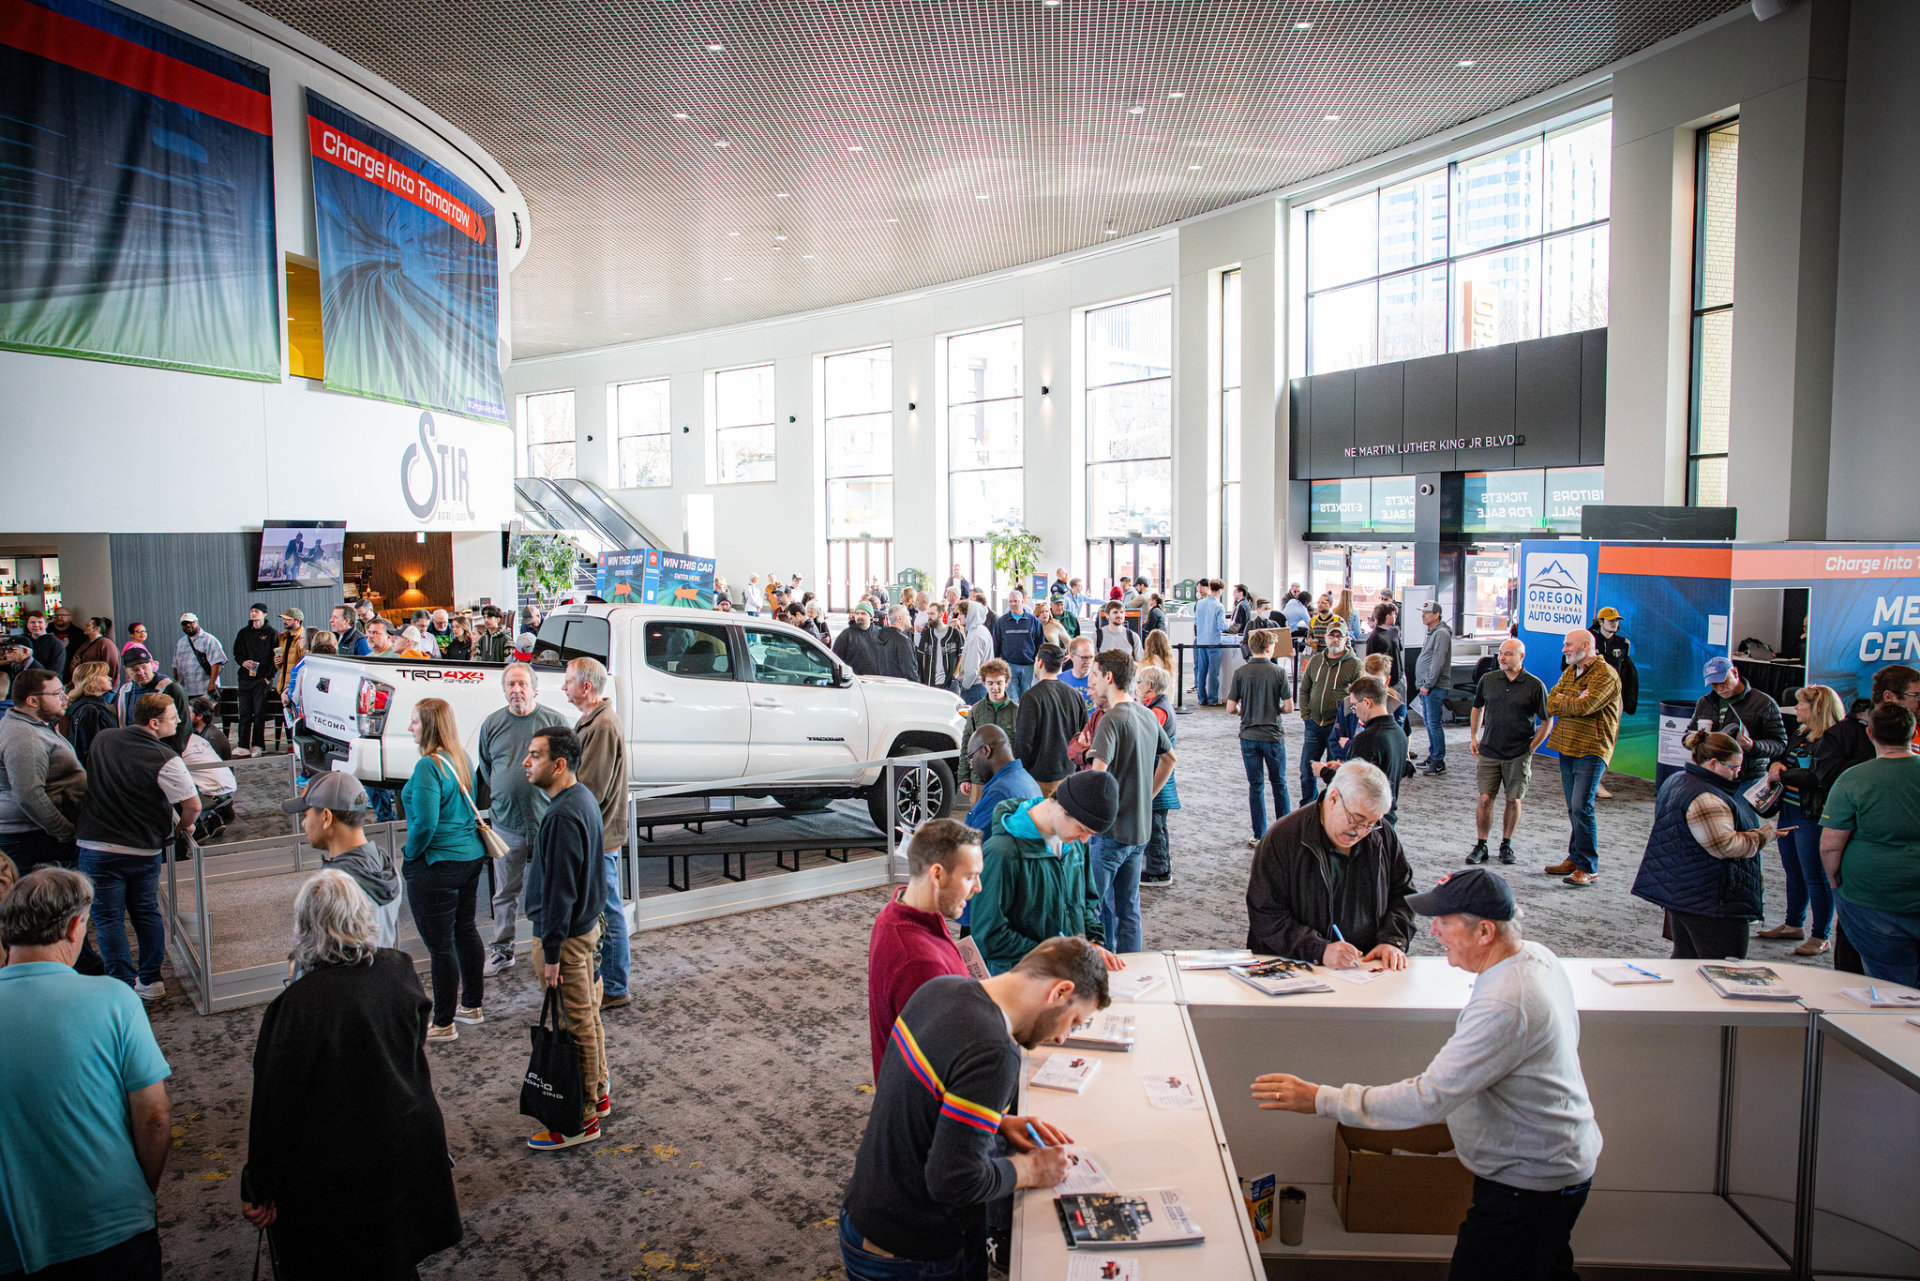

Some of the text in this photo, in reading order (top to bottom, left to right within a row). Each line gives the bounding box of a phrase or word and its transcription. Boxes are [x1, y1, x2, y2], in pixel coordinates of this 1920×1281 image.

[322, 130, 470, 228] Charge Into Tomorrow
[1344, 434, 1515, 457] NE MARTIN LUTHER KING JR BLVD
[607, 554, 643, 566] WIN THIS CAR
[663, 557, 714, 574] WIN THIS CAR
[1825, 555, 1880, 574] Charge
[1883, 555, 1912, 570] Into
[674, 573, 688, 581] ENTER
[1529, 590, 1583, 605] OREGON
[1528, 604, 1582, 613] INTERNATIONAL
[1872, 595, 1920, 627] ME
[1528, 610, 1582, 625] AUTO SHOW
[1859, 630, 1920, 662] CEN
[396, 669, 442, 681] TRD
[313, 715, 346, 731] TACOMA
